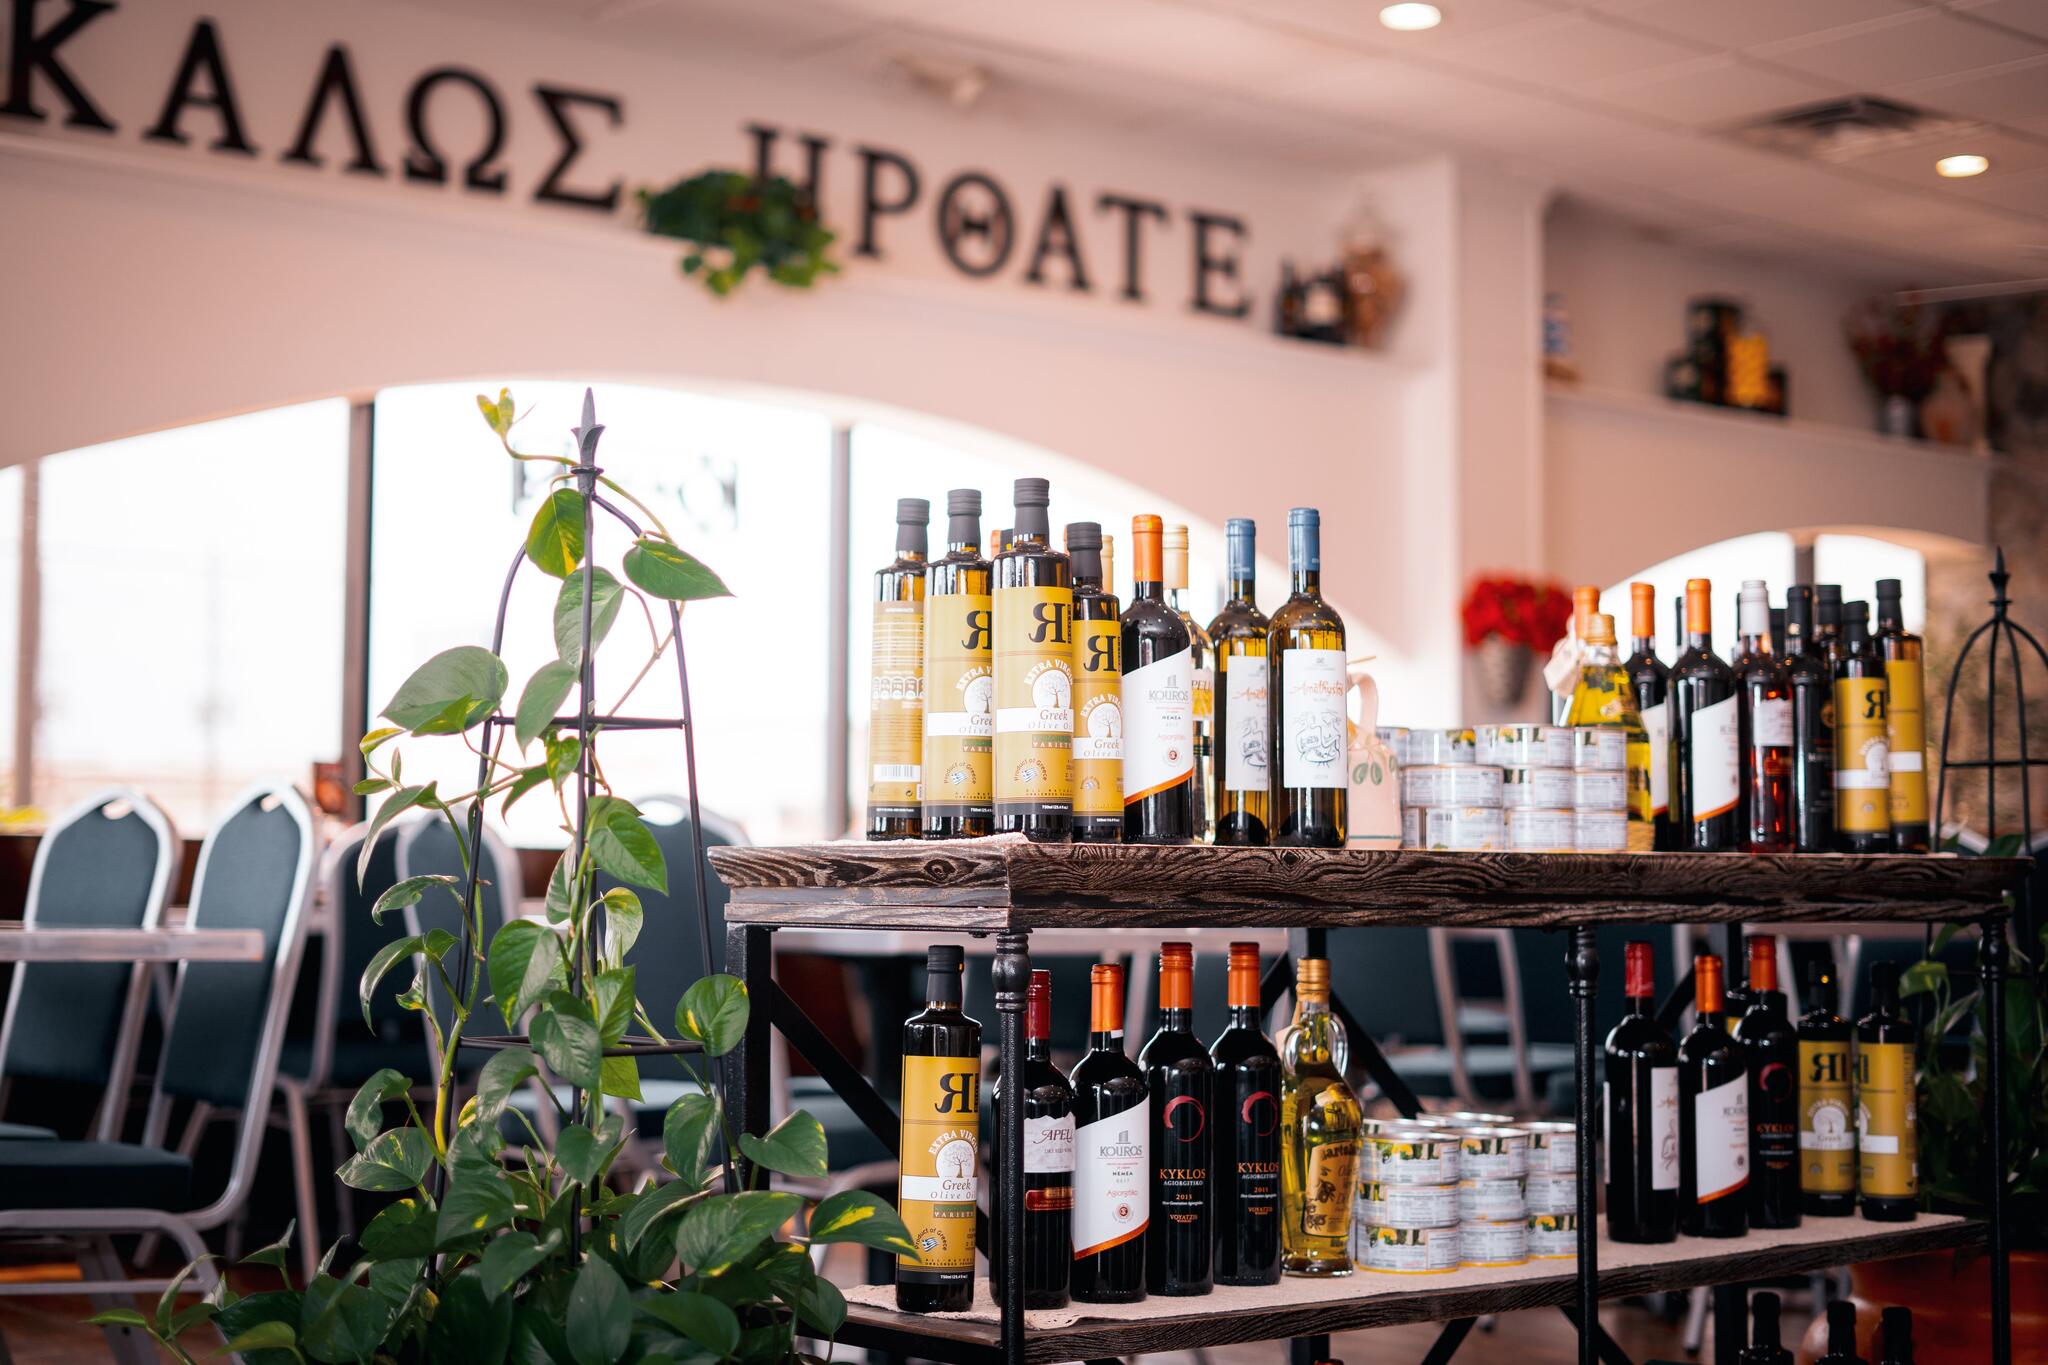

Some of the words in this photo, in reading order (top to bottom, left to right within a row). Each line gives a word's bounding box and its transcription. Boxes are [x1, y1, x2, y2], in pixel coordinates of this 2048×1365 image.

[0, 0, 624, 212] ΚΑΛΩΣ
[1148, 689, 1189, 702] KOUROS
[970, 713, 992, 727] Gree
[1039, 709, 1068, 721] Greek
[1093, 739, 1120, 750] Greek
[928, 1129, 958, 1156] EXTRA
[1099, 1144, 1143, 1157] KOUROS
[1237, 1161, 1279, 1173] KYKLOS
[1159, 1168, 1206, 1180] KYKLOS
[942, 1178, 972, 1191] Greek
[930, 1191, 961, 1200] Olive
